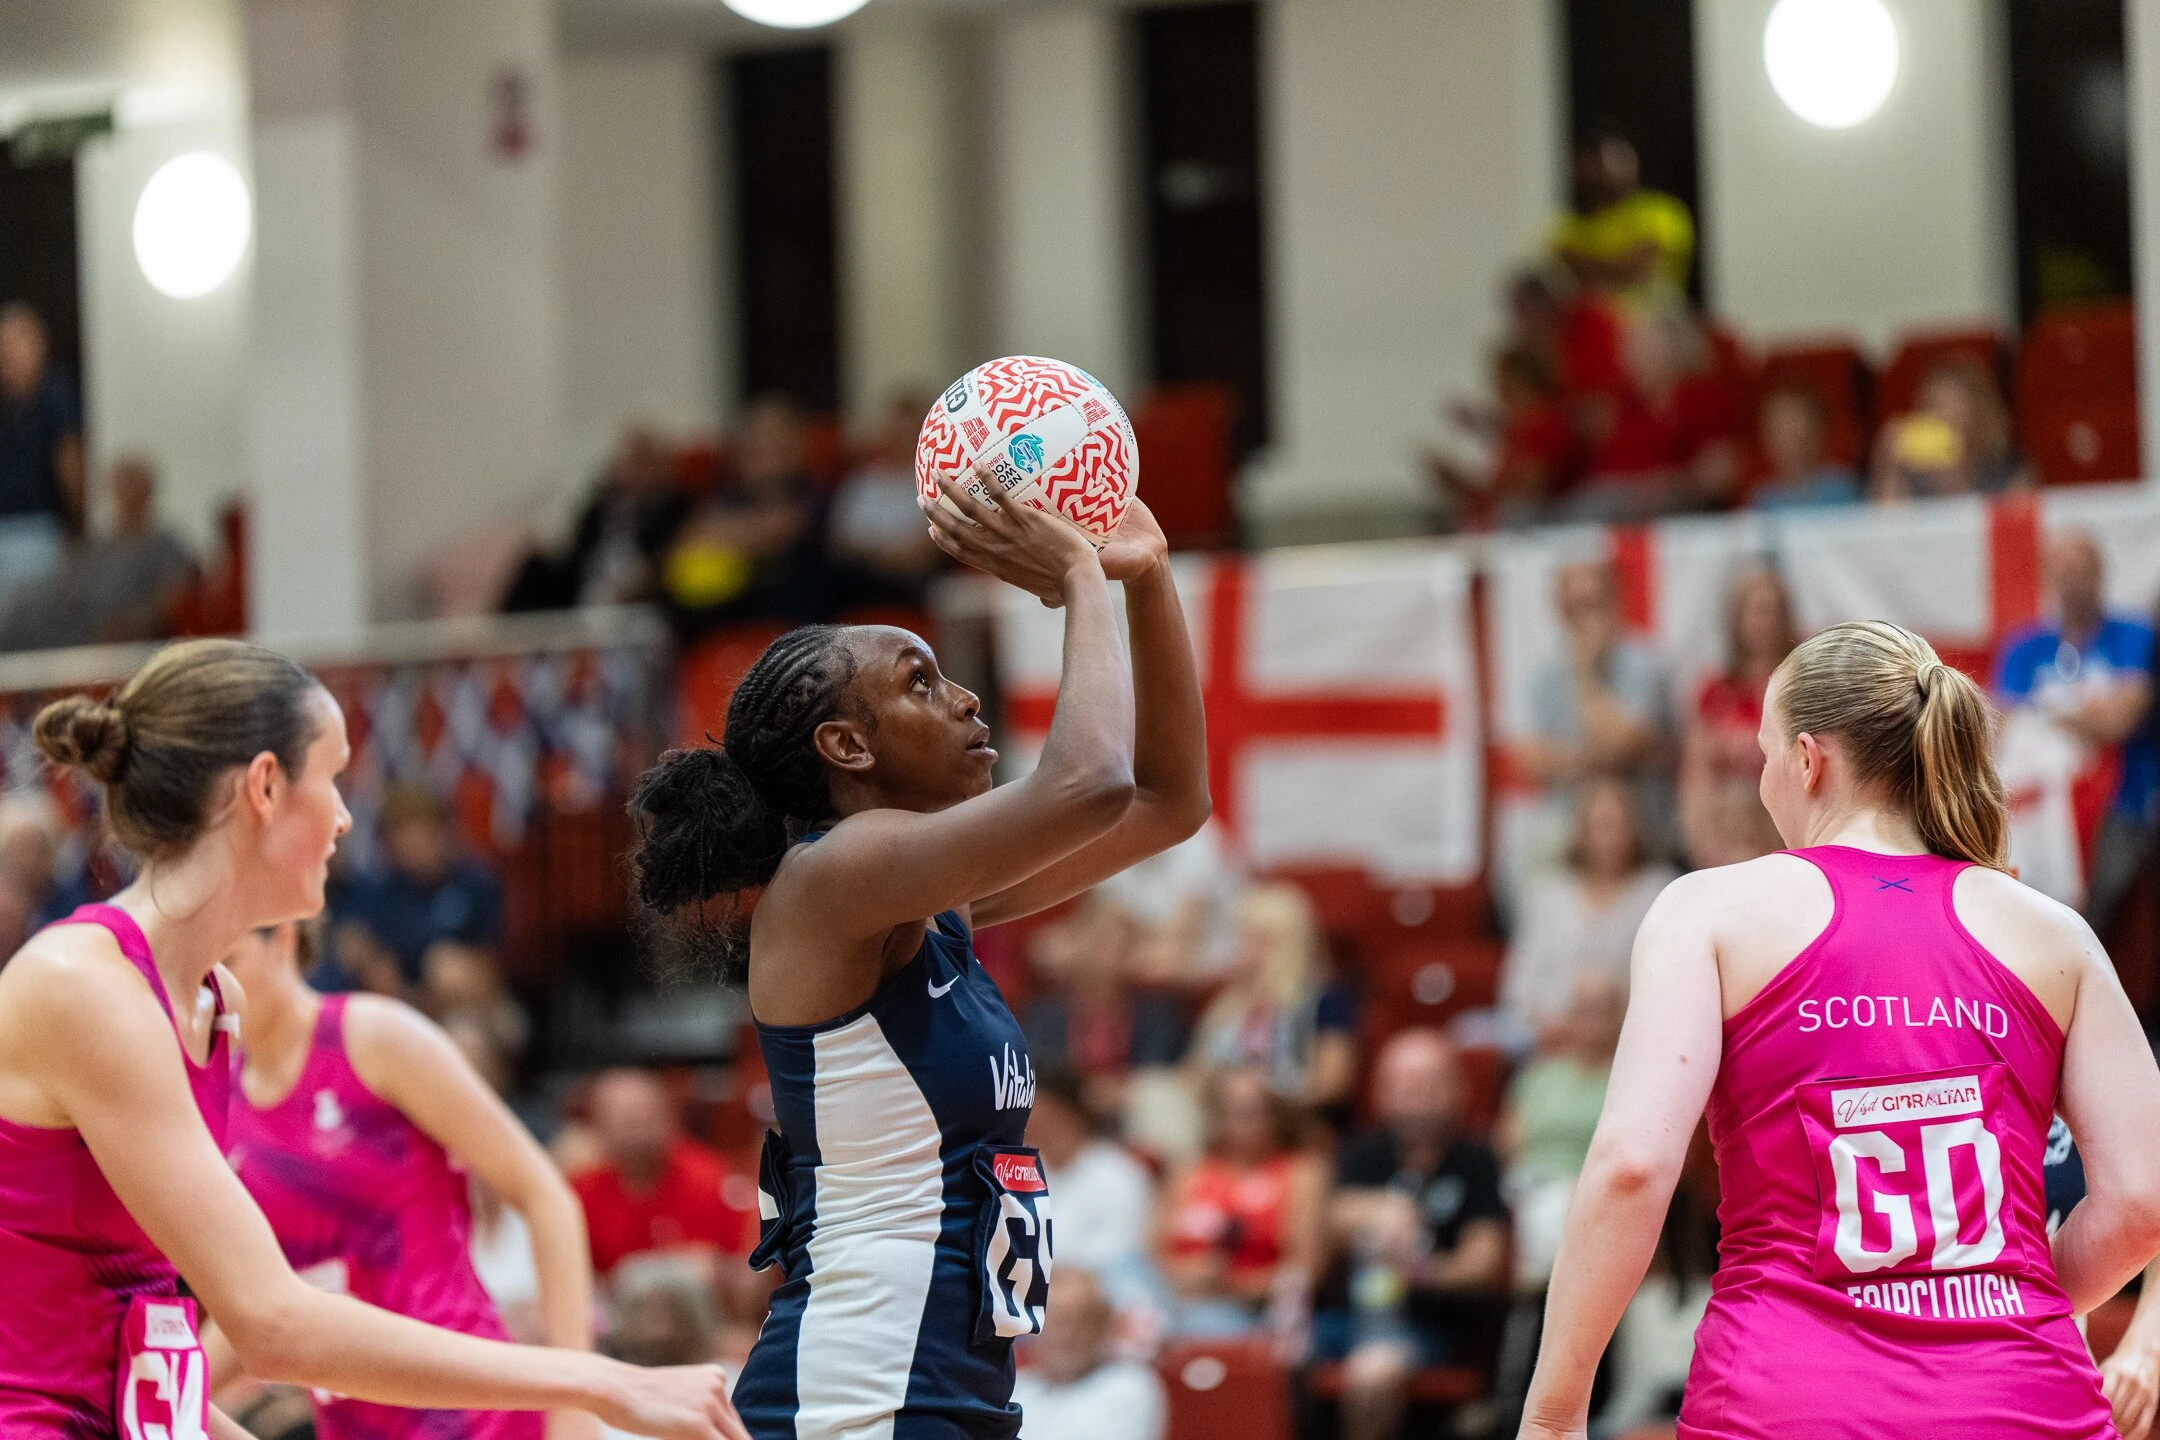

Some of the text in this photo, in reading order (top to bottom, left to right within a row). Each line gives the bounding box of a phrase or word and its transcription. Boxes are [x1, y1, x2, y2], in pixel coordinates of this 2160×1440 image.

[1797, 995, 2008, 1039] SCOTLAND
[1837, 1087, 1977, 1123] Visit GIBRALTAR
[1828, 1117, 2006, 1274] GD
